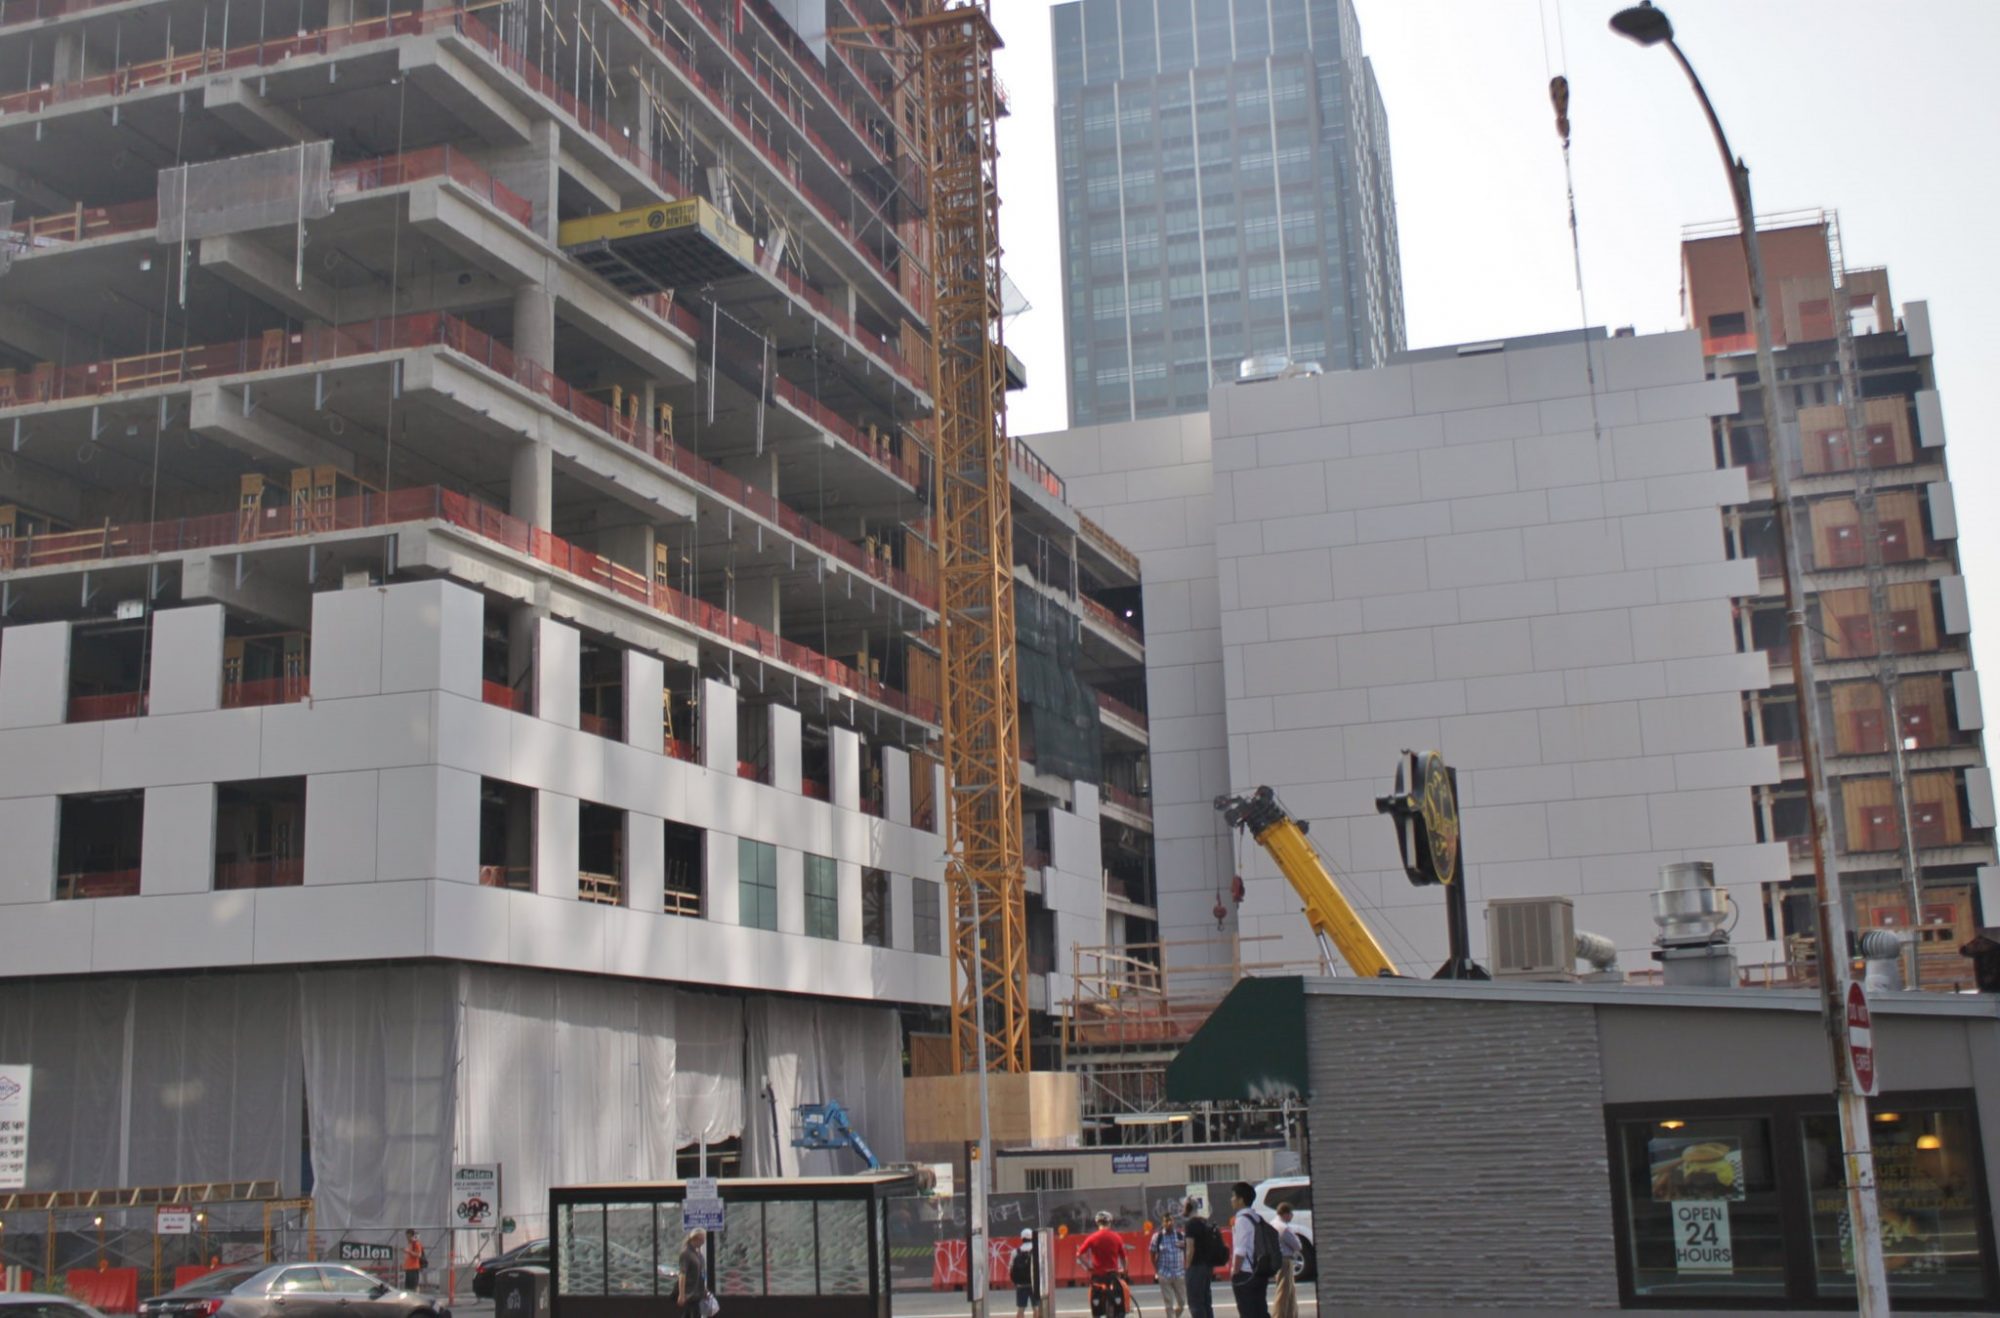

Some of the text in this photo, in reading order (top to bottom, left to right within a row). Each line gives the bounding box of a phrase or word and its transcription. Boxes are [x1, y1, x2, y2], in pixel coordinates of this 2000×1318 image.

[1678, 1207, 1722, 1221] OPEN
[1685, 1222, 1719, 1246] 24
[342, 1244, 390, 1259] Sellen
[1677, 1248, 1732, 1262] HOURS
